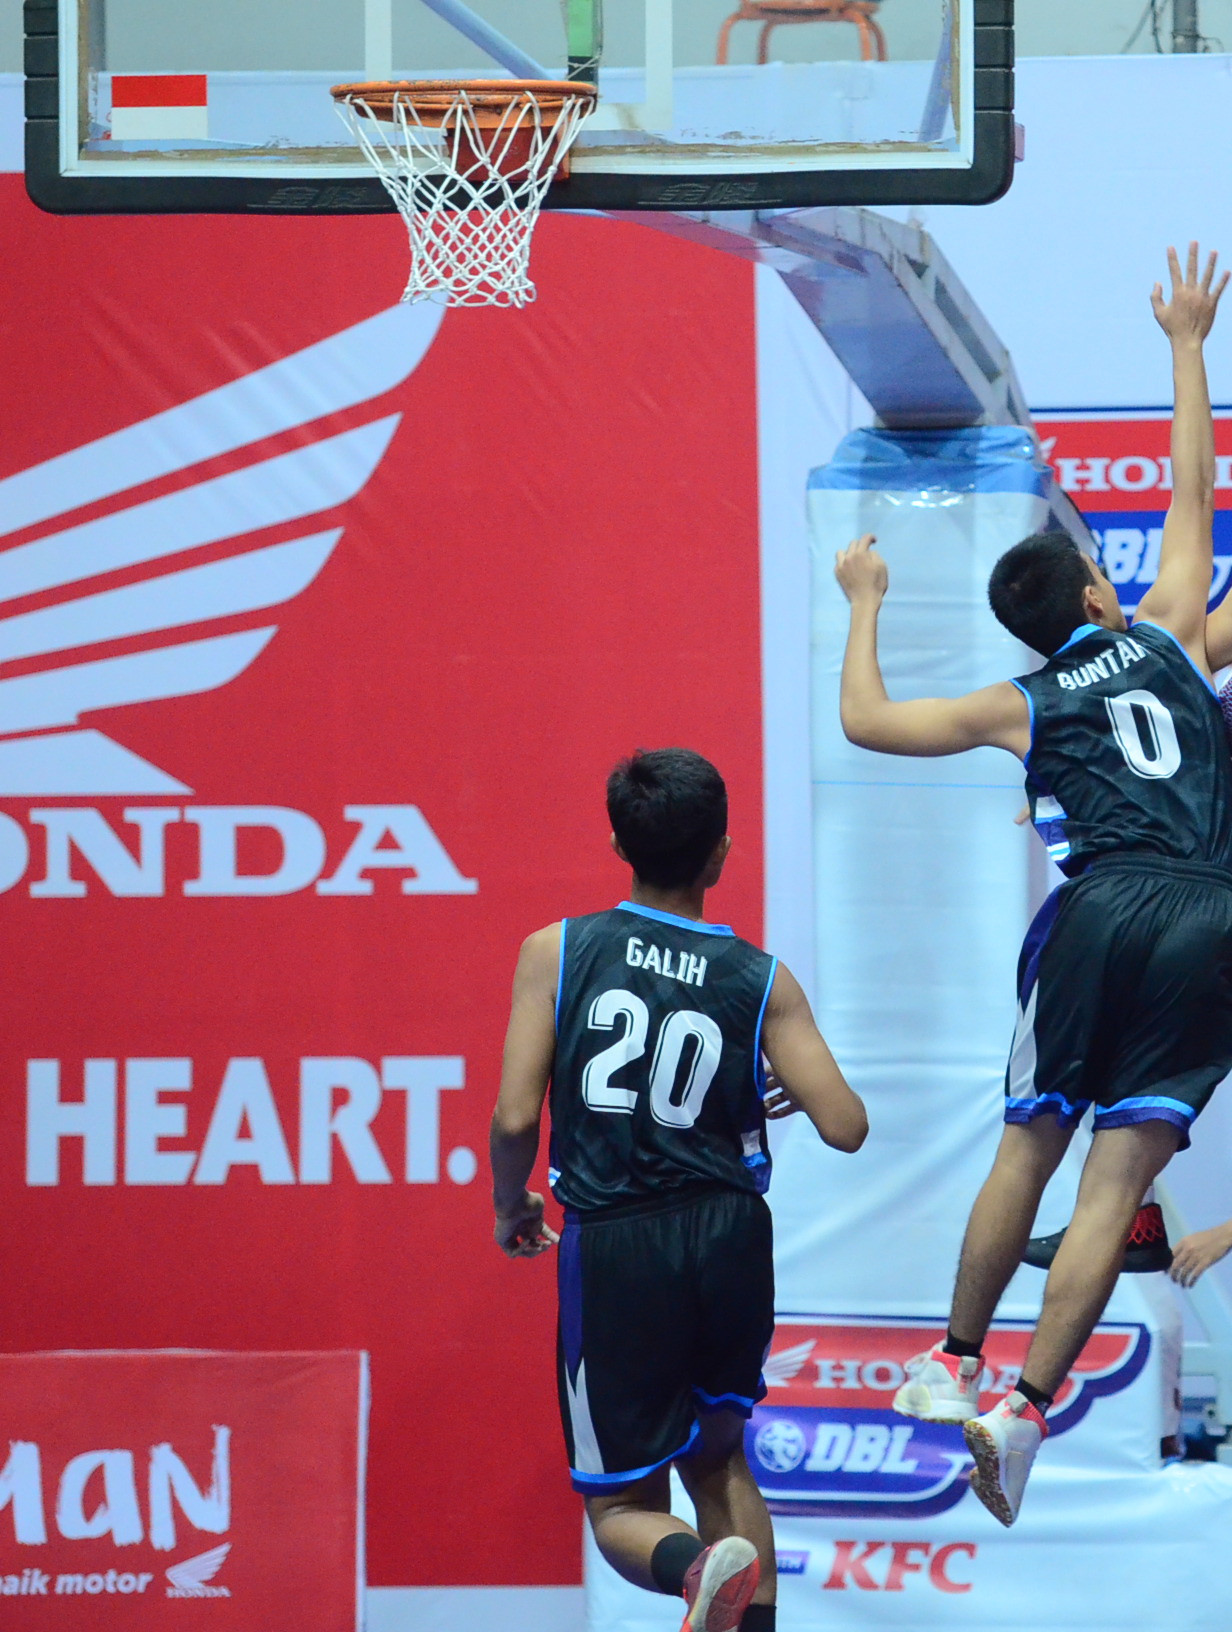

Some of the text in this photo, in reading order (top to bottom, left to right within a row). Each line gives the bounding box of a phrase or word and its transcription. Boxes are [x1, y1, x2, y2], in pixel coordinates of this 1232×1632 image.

[1091, 527, 1165, 584] BL
[1104, 689, 1181, 780] 0
[0, 804, 479, 898] NDA
[626, 936, 708, 987] GALIH
[582, 989, 723, 1129] 20
[25, 1056, 477, 1186] HEART.
[814, 1357, 1030, 1391] HOA
[804, 1422, 918, 1473] DBL
[0, 1568, 153, 1595] aik motor
[822, 1540, 977, 1594] KFC
